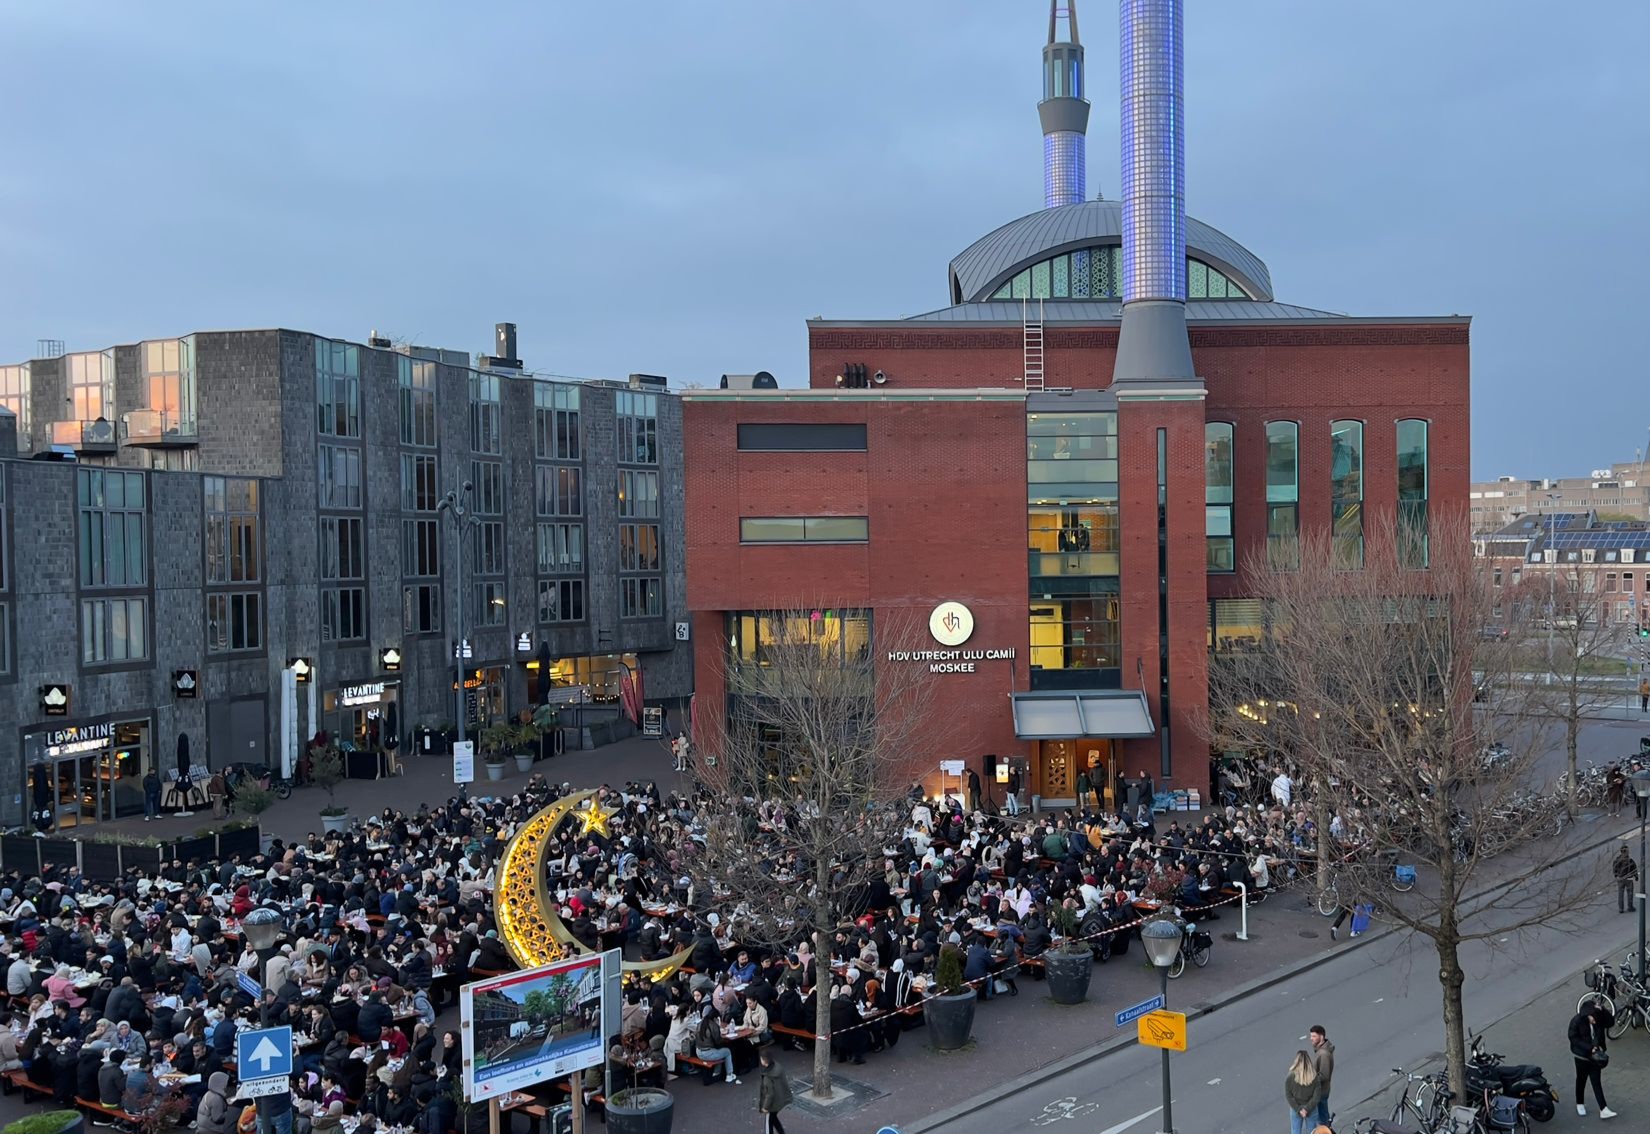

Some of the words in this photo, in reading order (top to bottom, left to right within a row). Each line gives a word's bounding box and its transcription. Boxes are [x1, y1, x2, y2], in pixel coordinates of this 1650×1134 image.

[888, 651, 911, 661] HDV
[912, 650, 960, 661] UTRECHT
[962, 650, 984, 660] ULU
[929, 663, 975, 674] MOSKEE
[342, 682, 385, 699] LEVANTINE
[47, 722, 116, 746] LEVANTINE
[1125, 1002, 1155, 1020] Kanaalstraat
[246, 1076, 286, 1088] uitgezonderd
